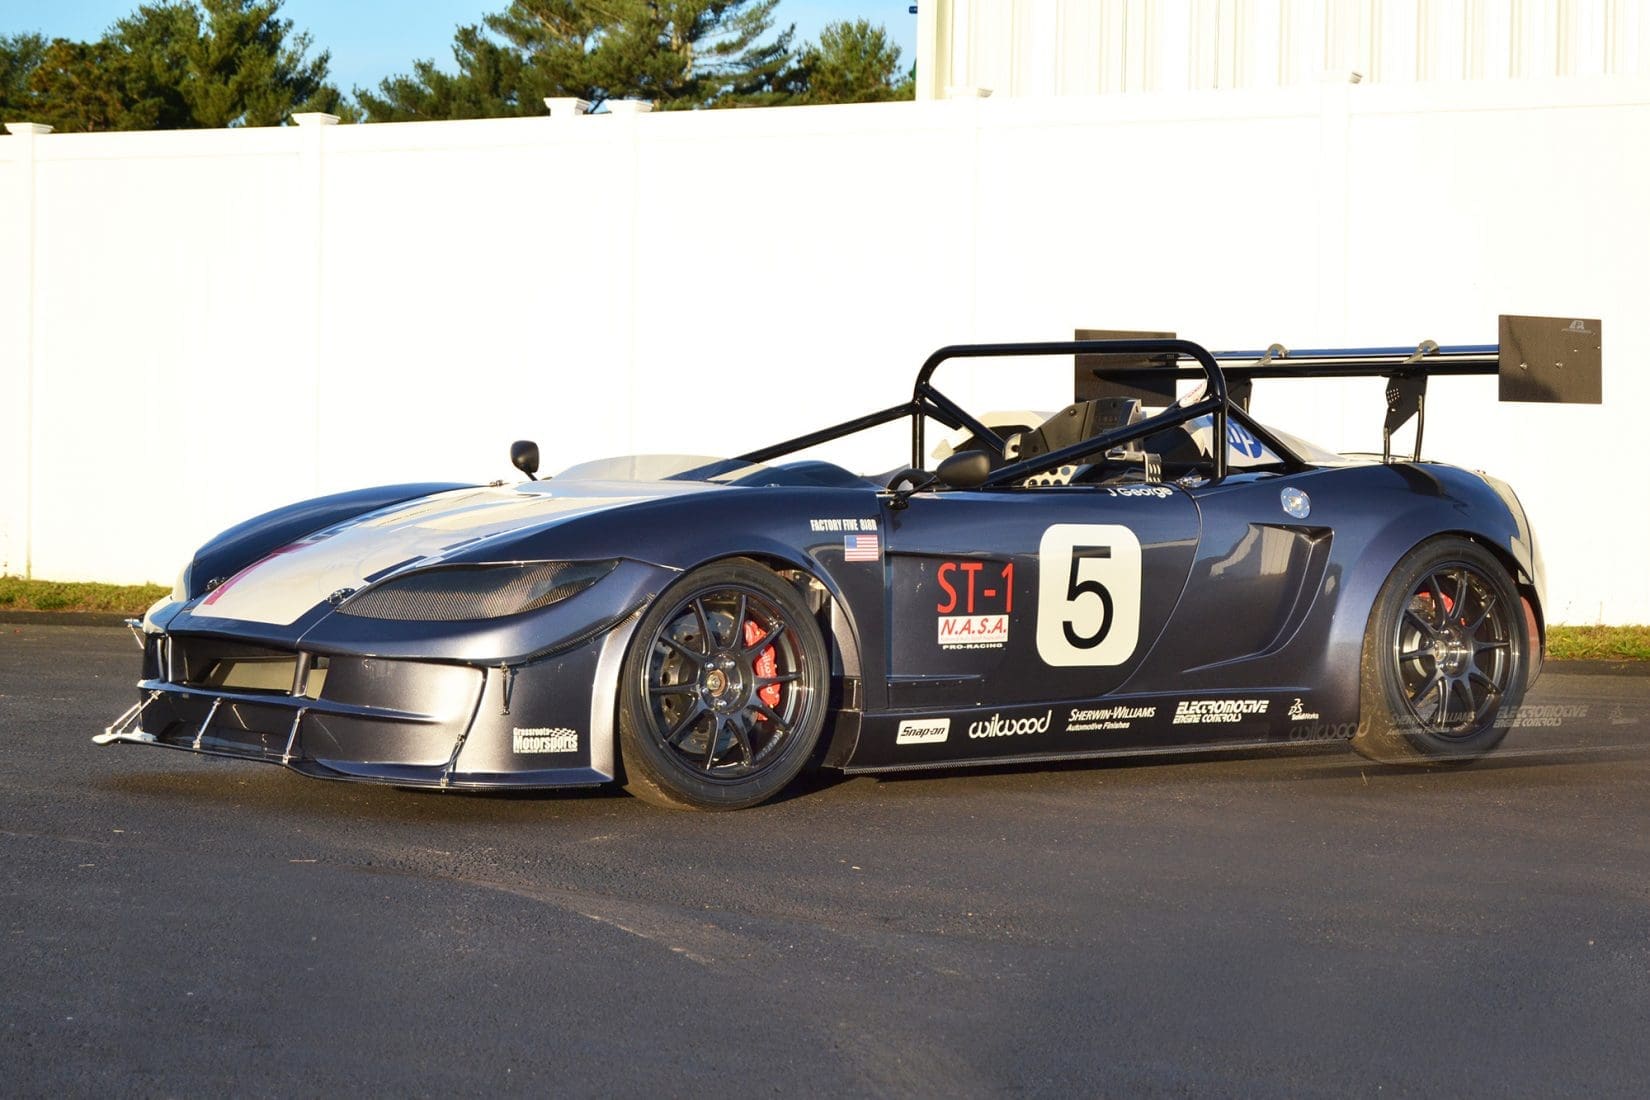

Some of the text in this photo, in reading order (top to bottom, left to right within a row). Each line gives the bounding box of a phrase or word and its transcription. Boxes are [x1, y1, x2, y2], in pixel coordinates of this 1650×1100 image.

[1106, 487, 1173, 498] J George
[810, 518, 842, 531] FACTORY
[842, 518, 859, 531] FIVE
[937, 562, 1014, 613] ST-1
[1062, 545, 1113, 650] 5
[940, 617, 1007, 635] N.A.S.A.
[1068, 705, 1157, 722] SHERWIN-WILLIAMS
[1176, 700, 1270, 715] ELECTROMOTIVE
[968, 709, 1053, 739] wilwood
[1066, 721, 1131, 732] Automotive Finishes
[1172, 713, 1242, 724] ENGINE CONTROLS
[900, 726, 946, 738] Snap-on
[513, 734, 578, 752] Motorsports
